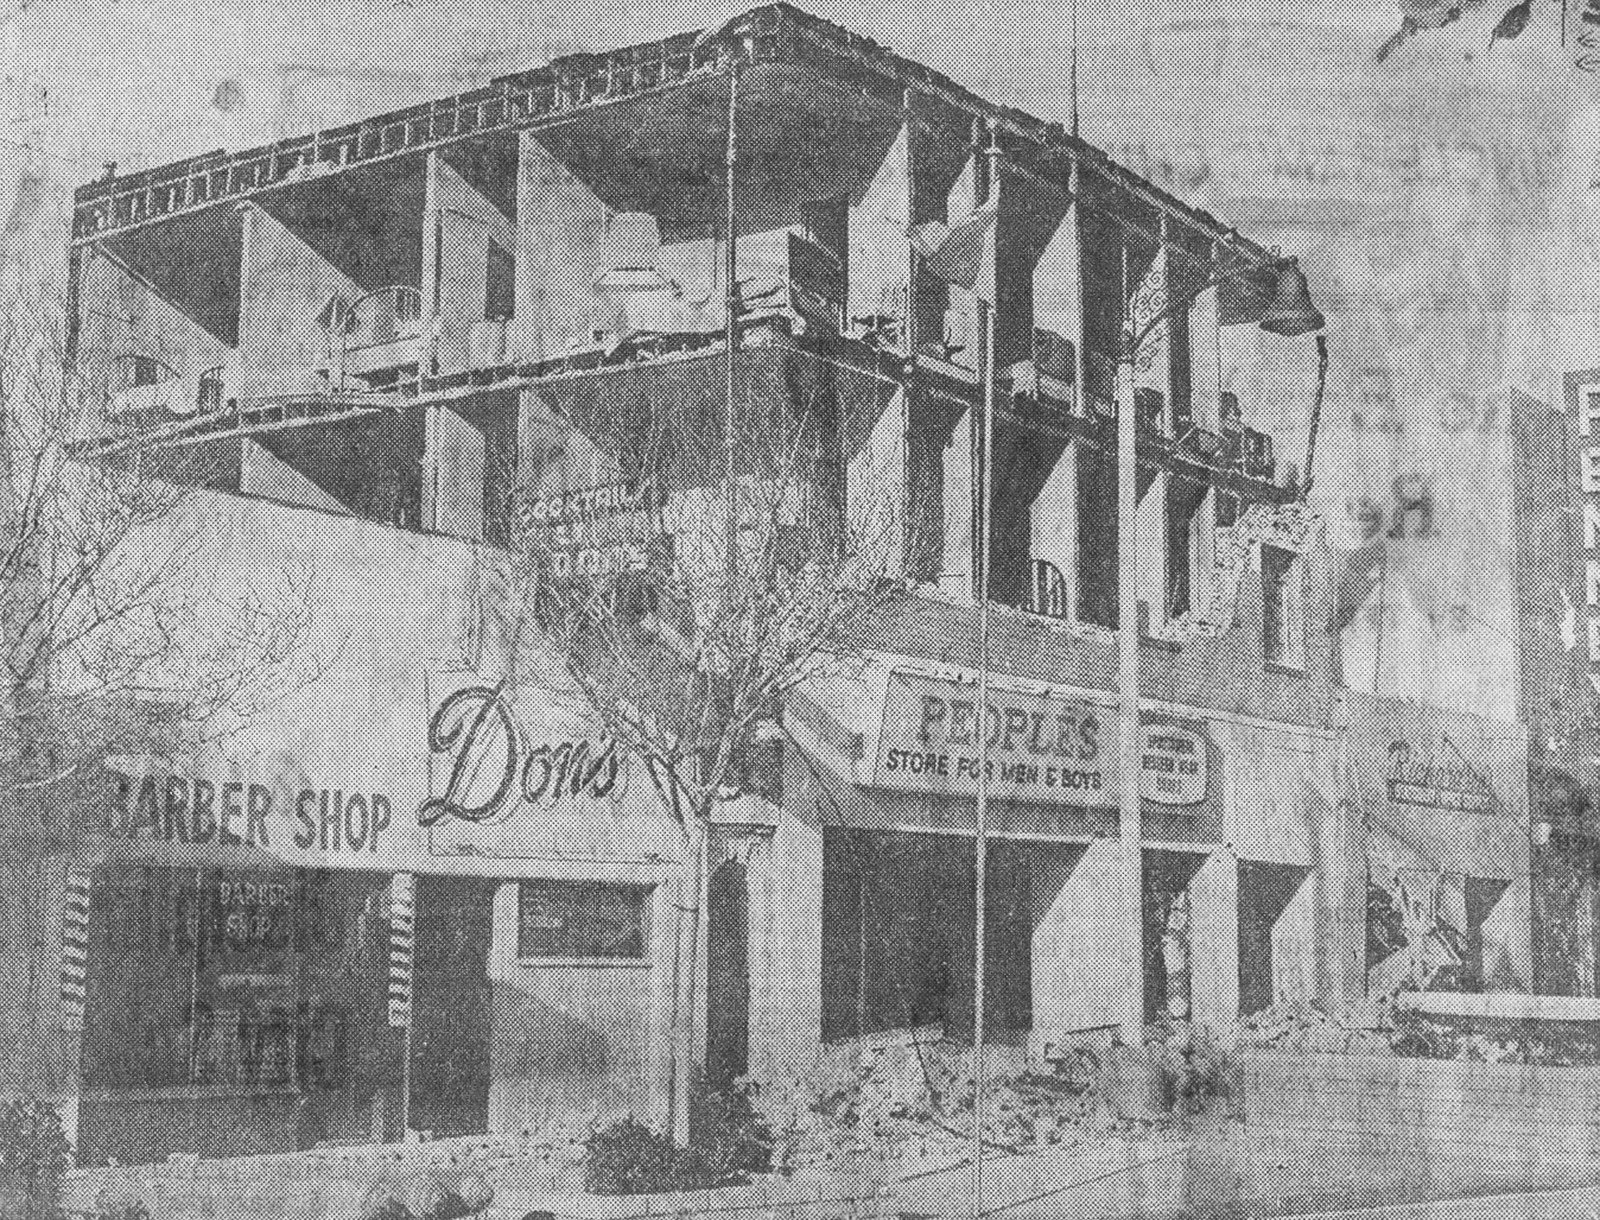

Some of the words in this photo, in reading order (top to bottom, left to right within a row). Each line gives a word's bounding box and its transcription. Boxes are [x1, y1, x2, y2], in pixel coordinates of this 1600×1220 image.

[917, 695, 1100, 761] PEOPLES
[886, 748, 948, 776] STORE
[957, 757, 993, 782] FOR
[1000, 761, 1039, 785] MEN
[1061, 767, 1103, 791] BOYS
[106, 771, 272, 848] BARBER
[293, 789, 391, 852] SHOP
